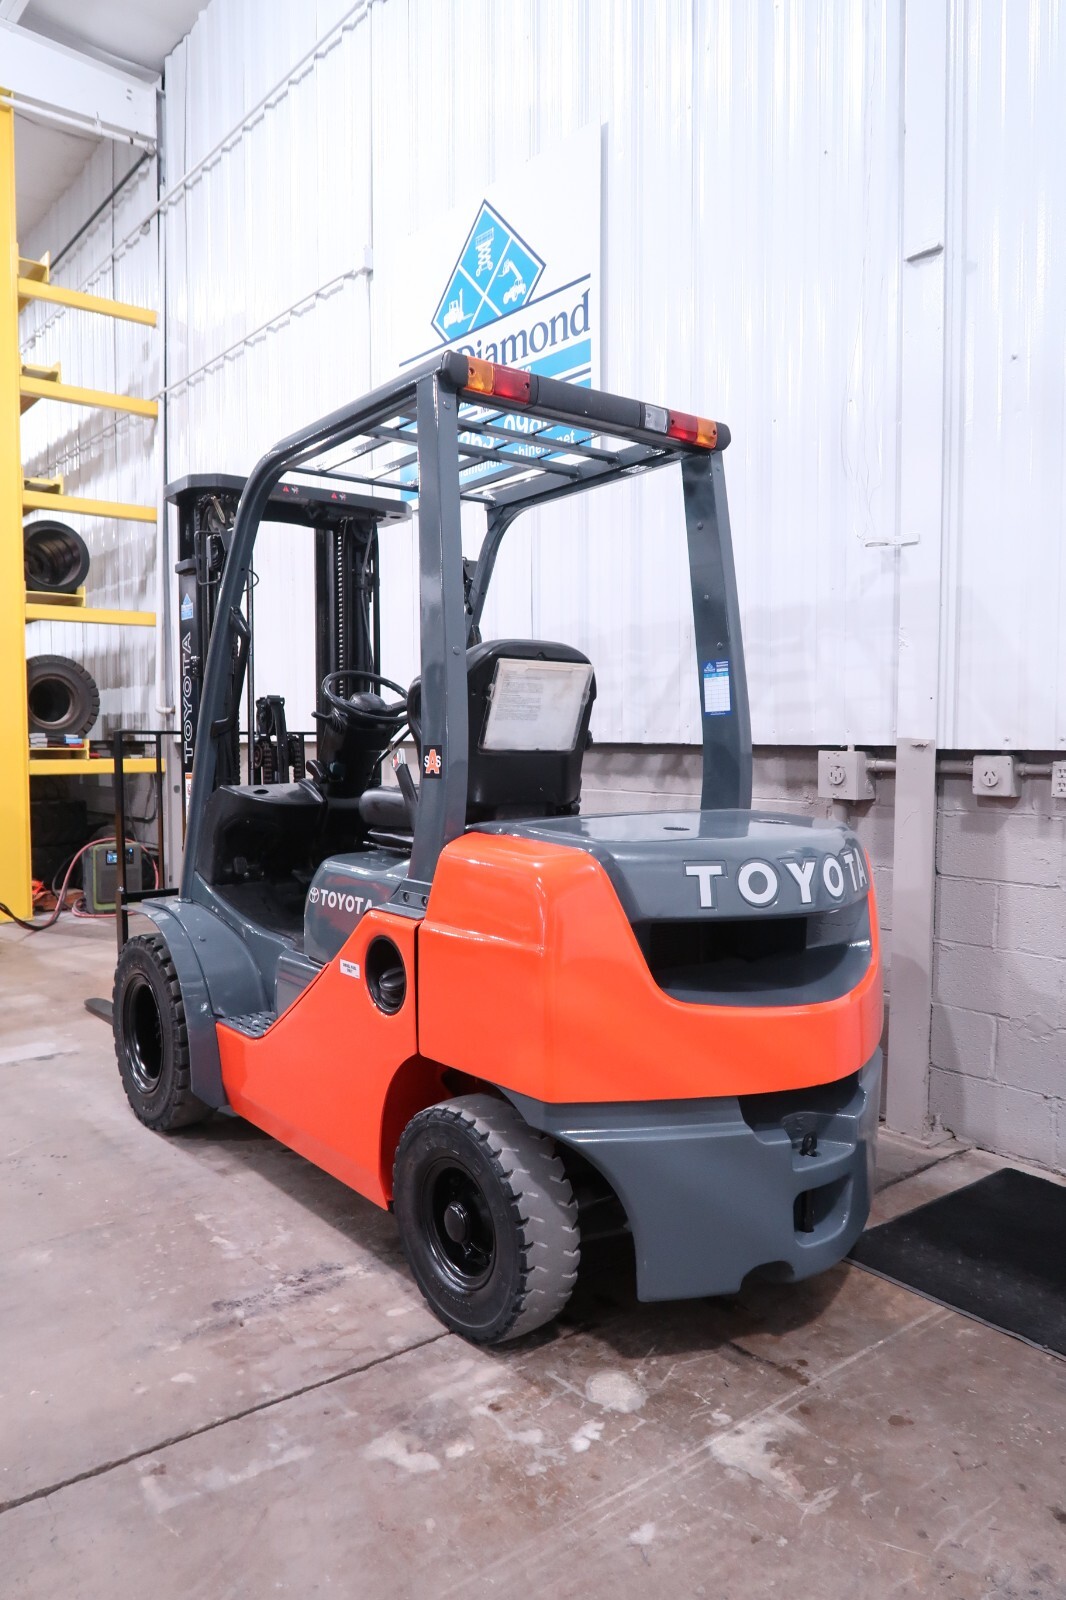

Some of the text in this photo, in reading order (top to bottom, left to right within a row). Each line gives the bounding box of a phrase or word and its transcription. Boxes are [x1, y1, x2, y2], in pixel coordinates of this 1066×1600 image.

[182, 631, 194, 764] TOYOTA
[424, 749, 442, 774] SAS
[685, 848, 868, 908] TOYOTA
